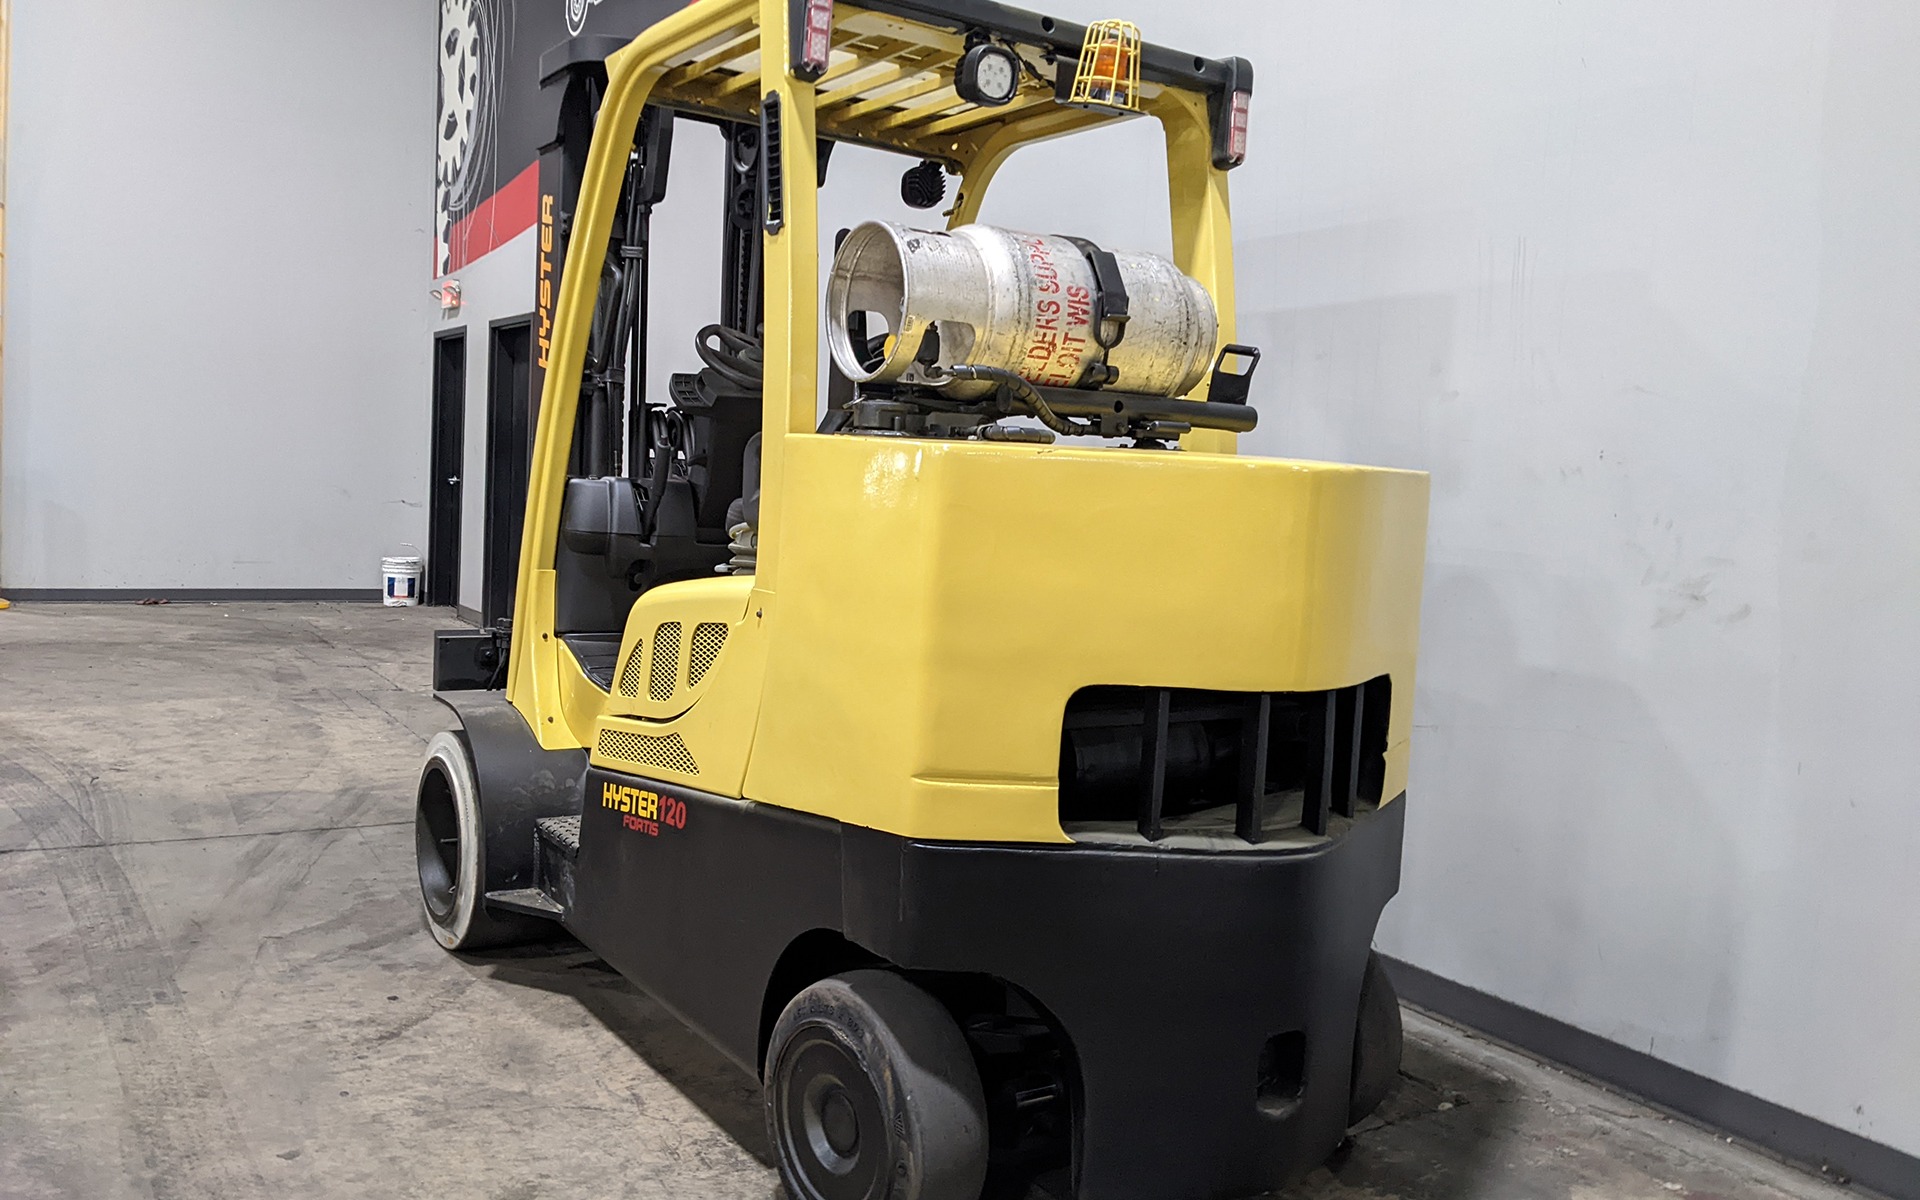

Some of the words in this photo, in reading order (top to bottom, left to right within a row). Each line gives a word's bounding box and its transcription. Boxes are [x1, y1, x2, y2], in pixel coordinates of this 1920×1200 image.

[538, 194, 554, 369] HYSTER
[1066, 285, 1091, 326] WIS
[602, 781, 659, 820] HYSTER
[659, 795, 687, 830] 120
[623, 814, 660, 837] FORTIS
